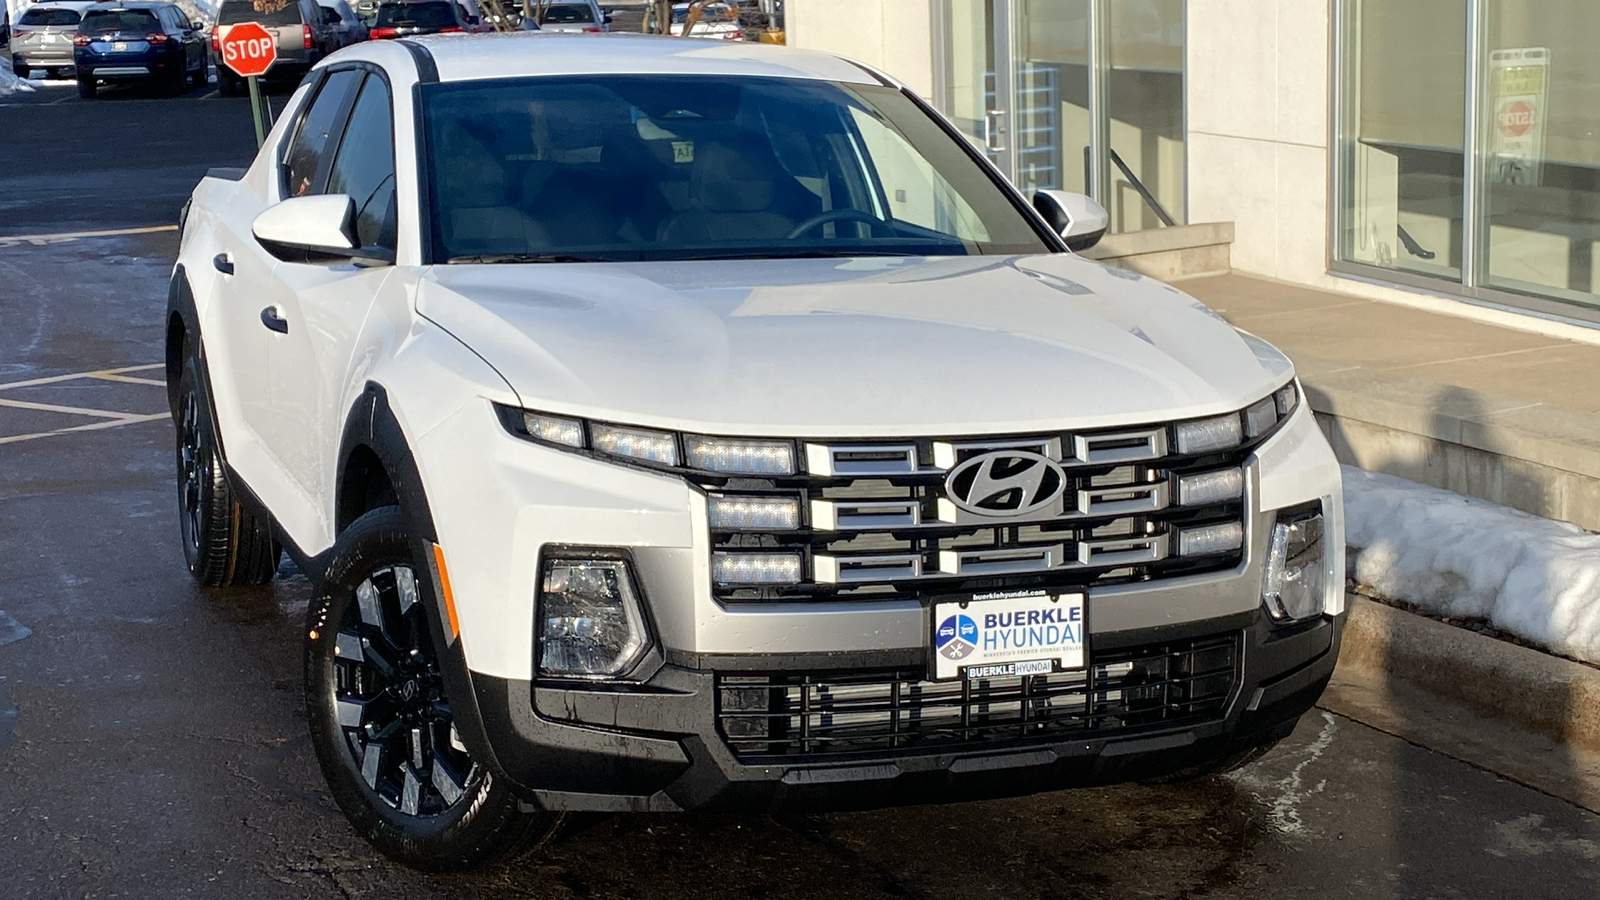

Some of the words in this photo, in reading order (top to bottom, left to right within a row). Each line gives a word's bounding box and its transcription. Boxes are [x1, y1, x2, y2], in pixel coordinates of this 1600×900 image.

[225, 37, 272, 61] STOP
[973, 590, 1046, 601] buerklehyundai.com
[984, 606, 1081, 629] BUERKLE
[984, 624, 1081, 651] HYUNDAI
[969, 664, 1015, 678] BUERKLE
[1016, 662, 1050, 673] HYUNDAI
